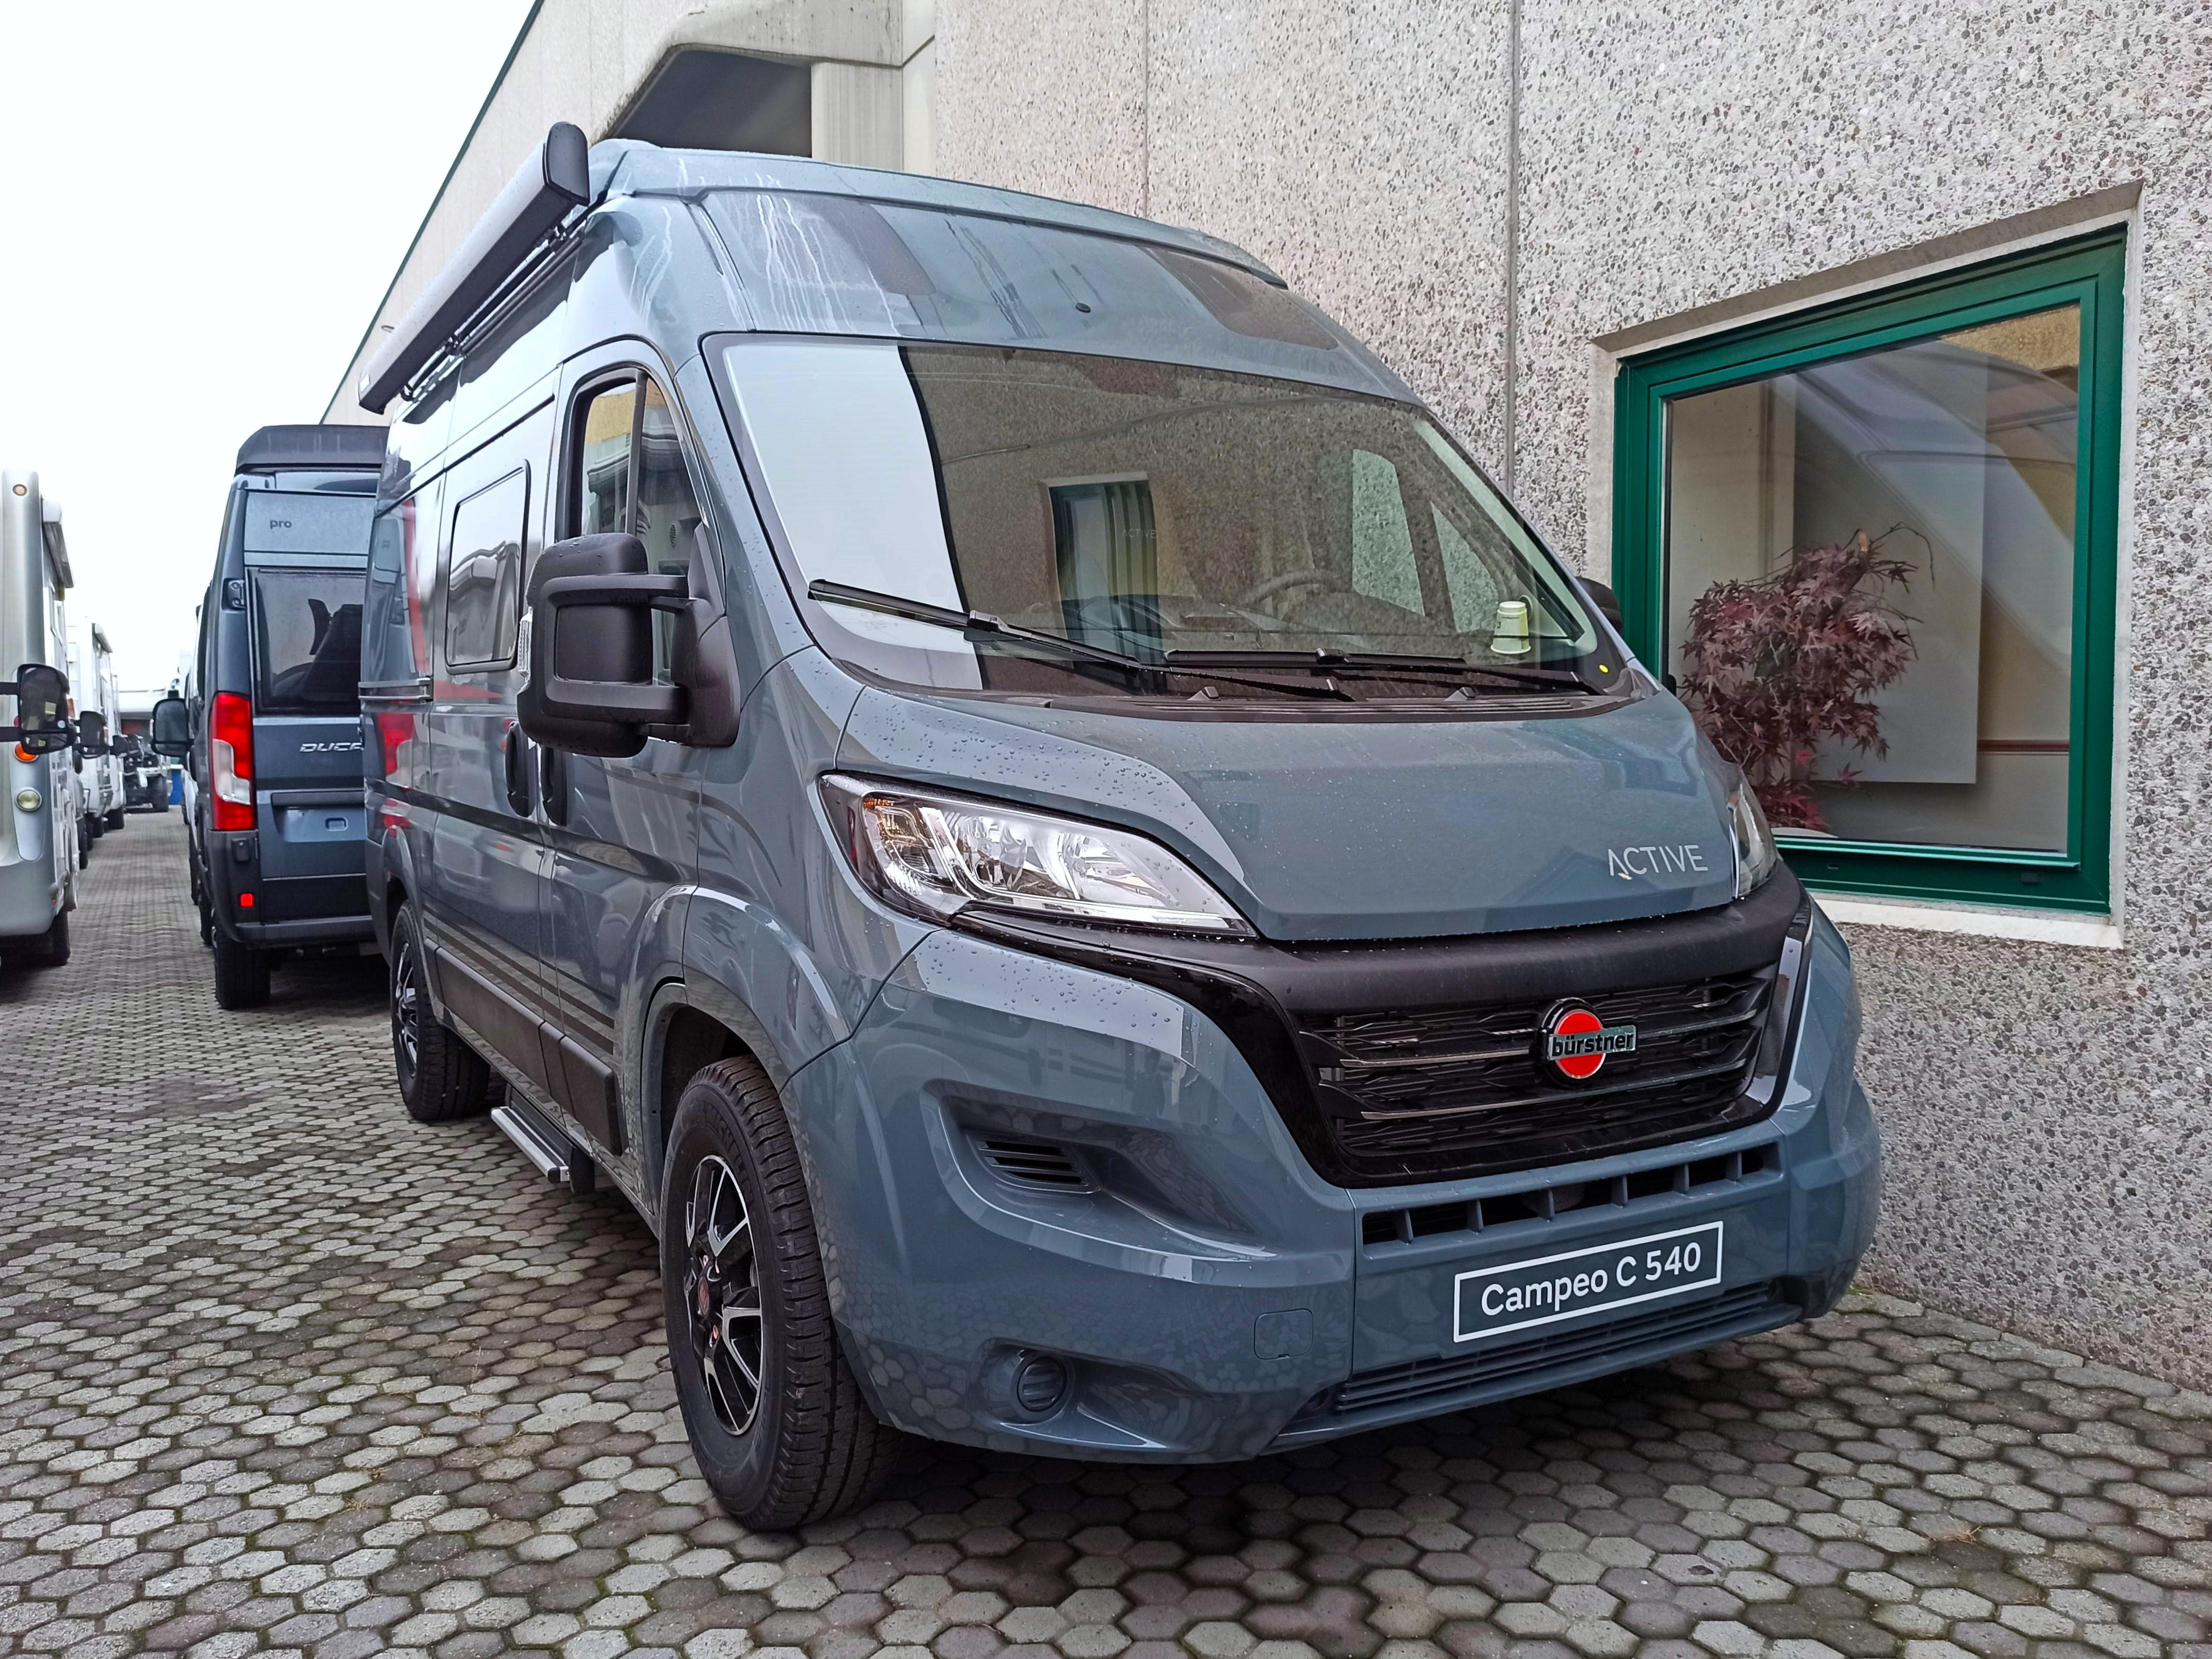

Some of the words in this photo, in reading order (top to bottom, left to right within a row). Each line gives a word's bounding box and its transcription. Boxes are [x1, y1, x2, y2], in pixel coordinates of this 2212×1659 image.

[270, 520, 292, 529] pro
[1608, 844, 1708, 880] ACTIVE
[1552, 1033, 1634, 1057] bürstner
[1481, 1270, 1608, 1316] Campeo
[1616, 1256, 1637, 1287] C
[1645, 1242, 1702, 1281] 540
